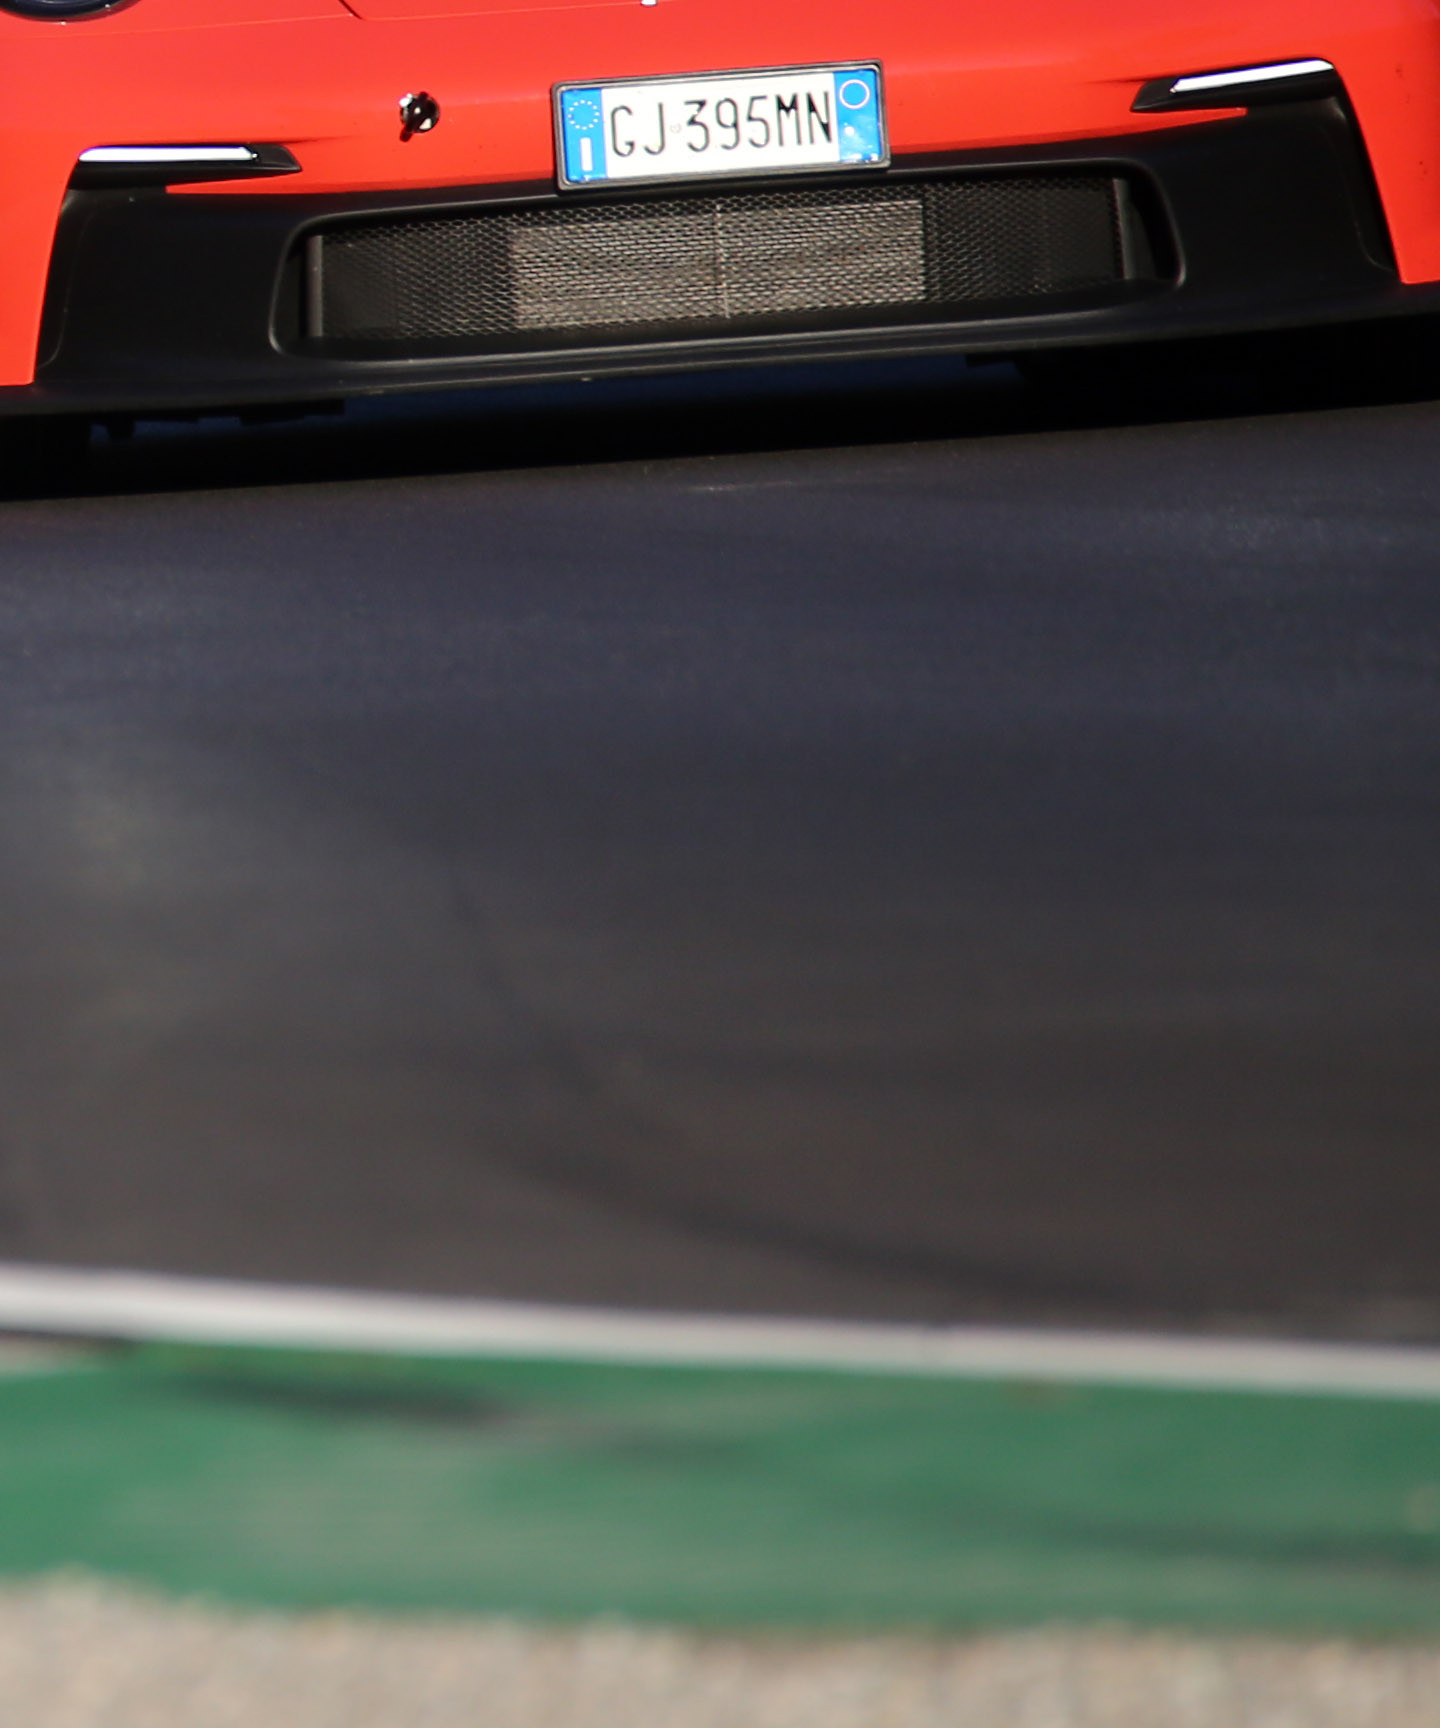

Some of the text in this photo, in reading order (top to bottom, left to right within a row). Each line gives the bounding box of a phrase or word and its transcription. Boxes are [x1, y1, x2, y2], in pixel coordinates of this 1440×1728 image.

[610, 91, 833, 158] GJ 395MN
[579, 136, 593, 171] I
